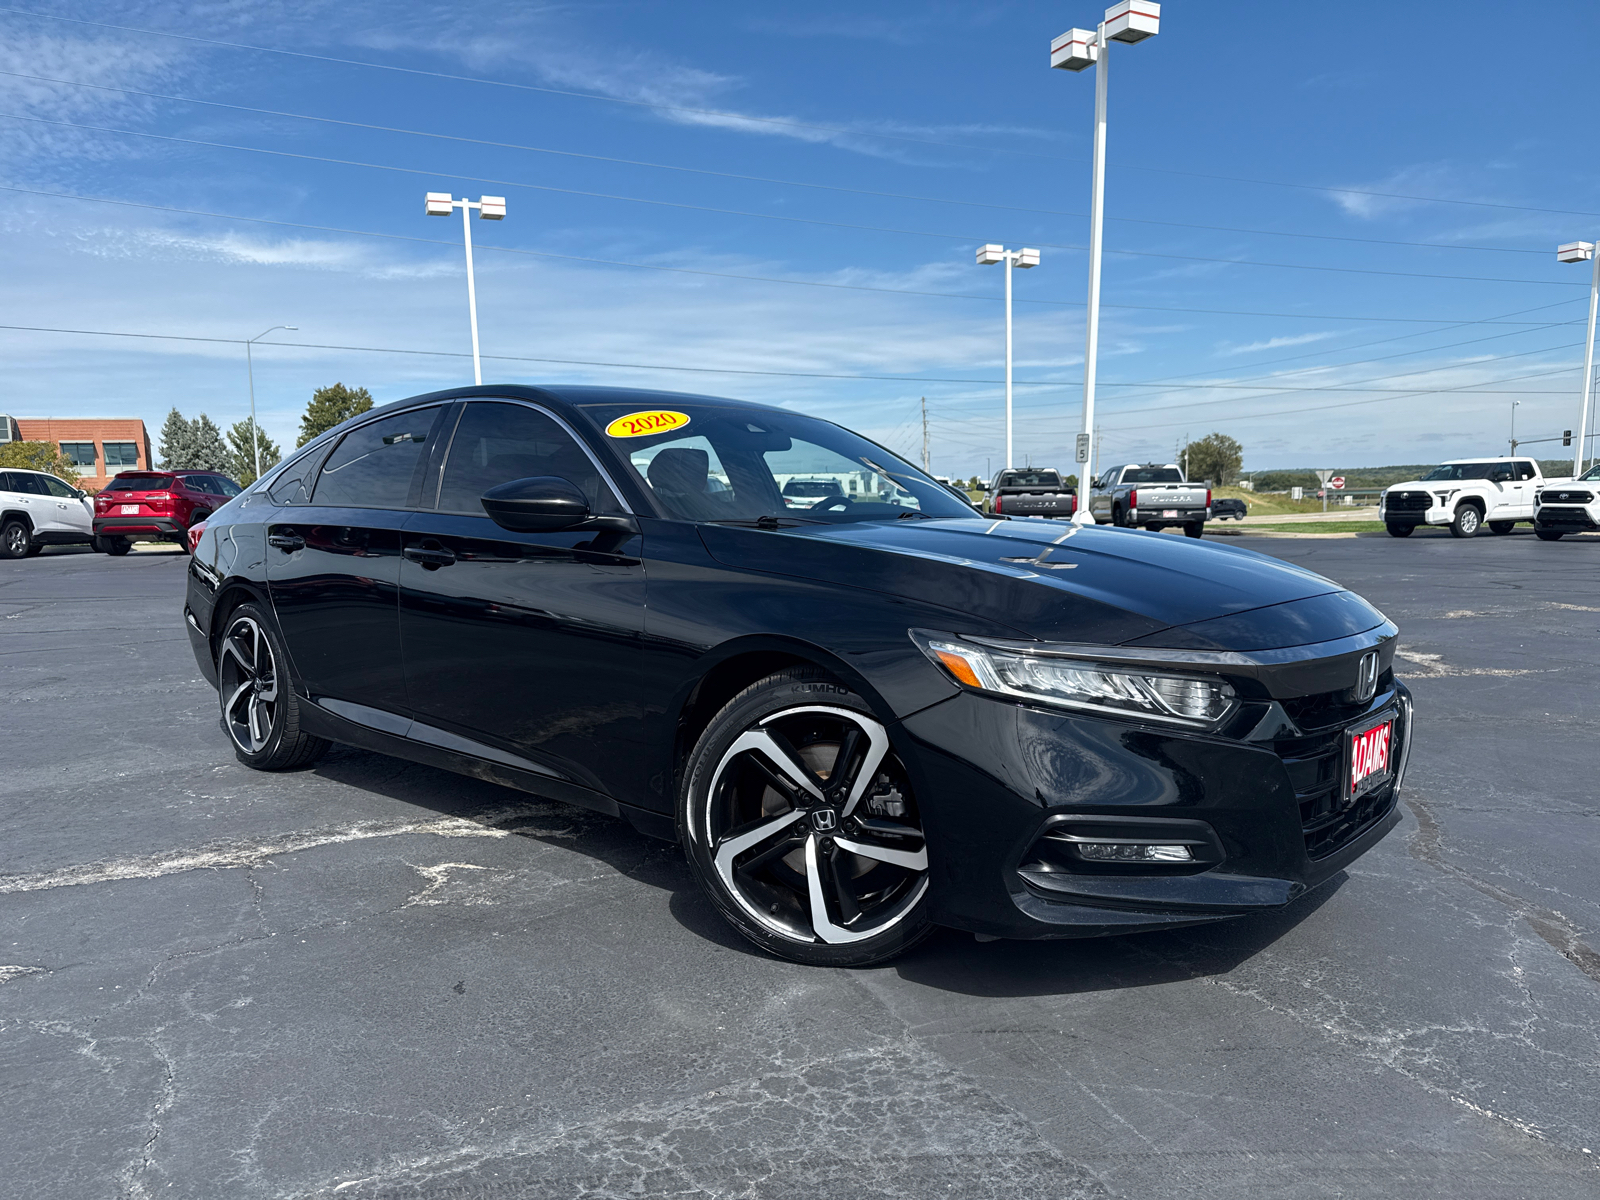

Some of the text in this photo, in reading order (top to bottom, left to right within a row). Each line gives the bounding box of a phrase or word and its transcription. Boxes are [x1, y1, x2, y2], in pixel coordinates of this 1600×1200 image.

[622, 413, 677, 434] 2020
[1079, 449, 1085, 459] 5
[791, 683, 849, 696] KUMHO
[1352, 726, 1388, 784] ADAMS
